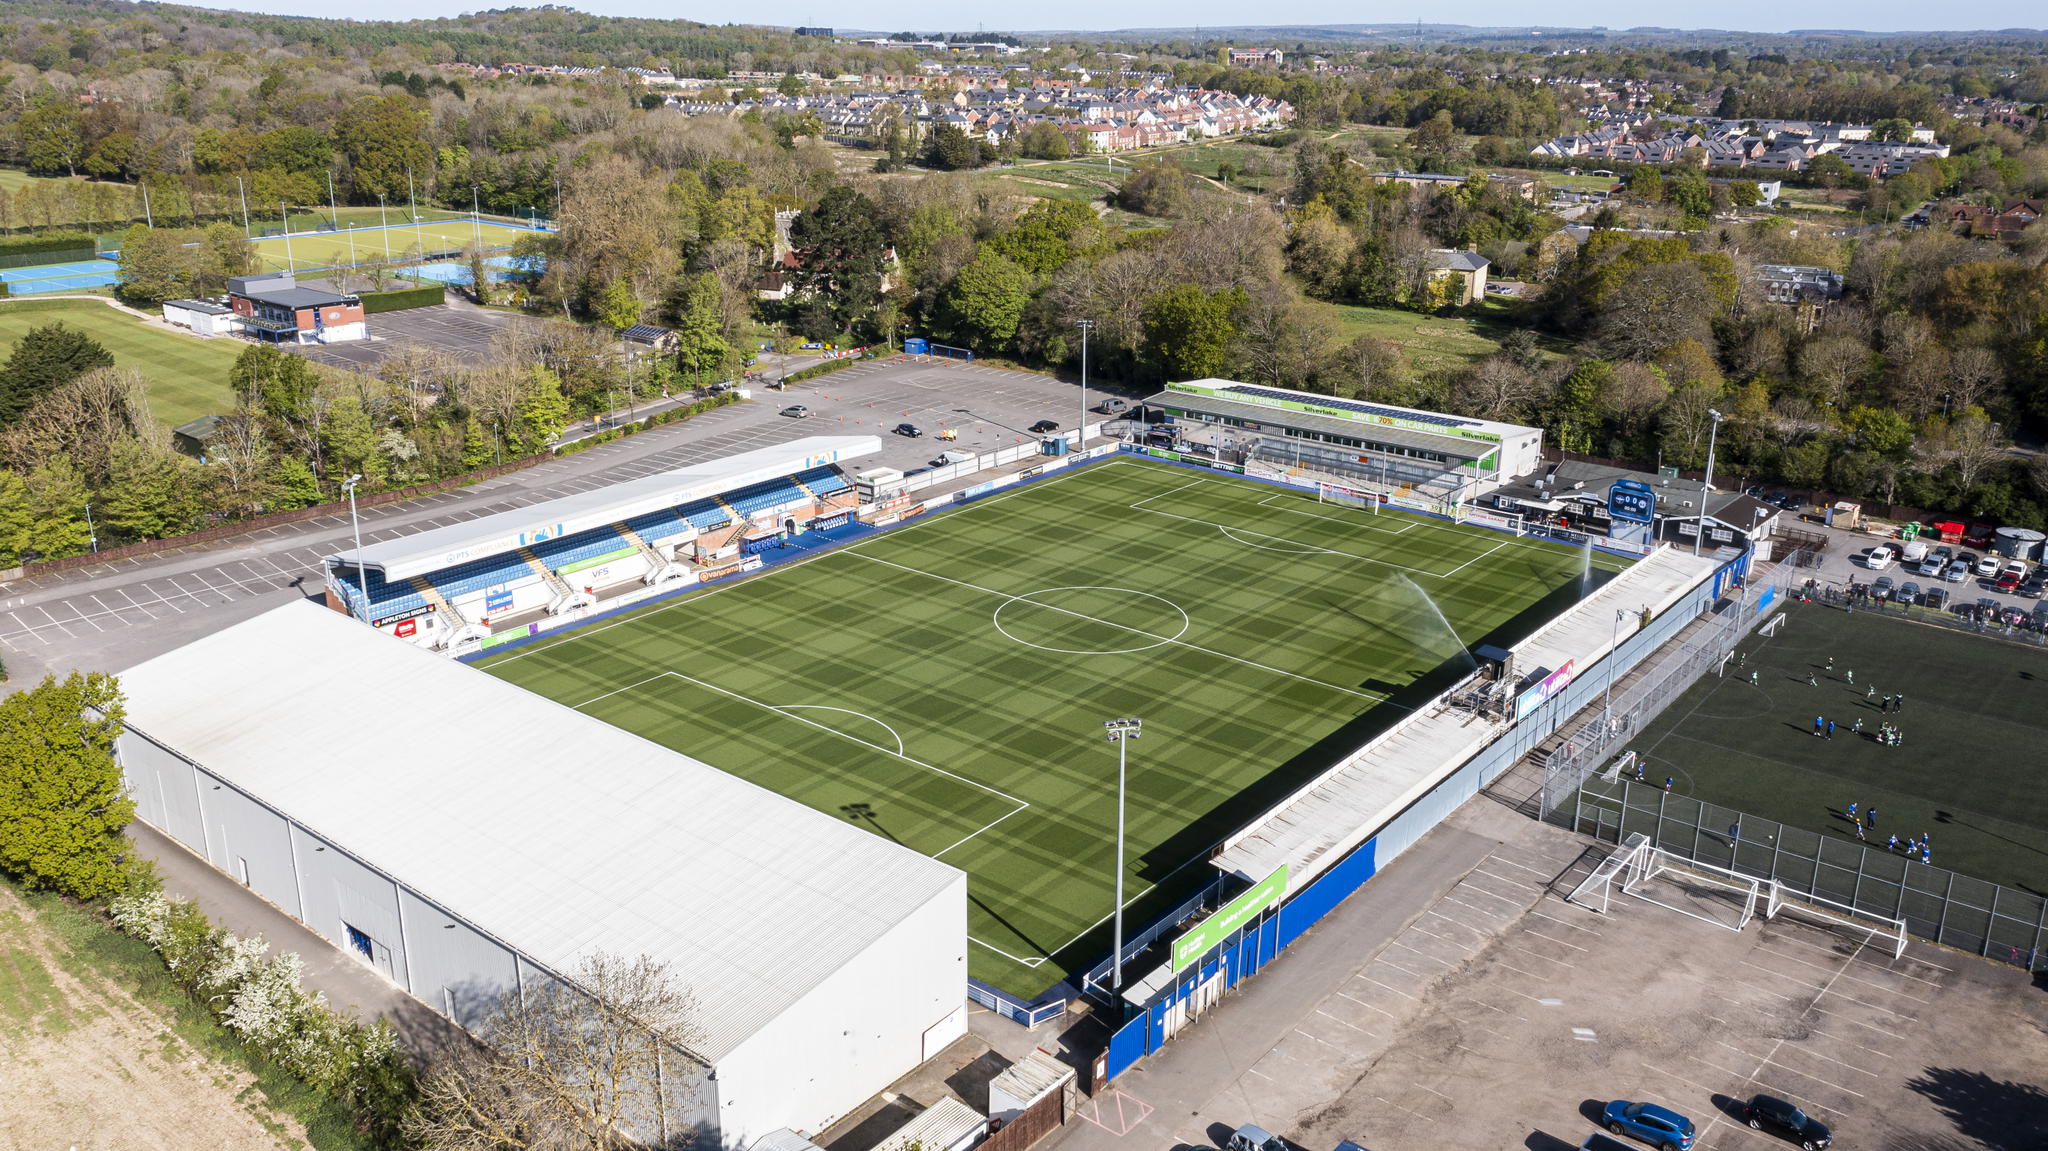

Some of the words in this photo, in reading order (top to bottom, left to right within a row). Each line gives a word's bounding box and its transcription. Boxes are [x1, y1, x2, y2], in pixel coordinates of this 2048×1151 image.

[1379, 416, 1393, 425] 70%
[1394, 419, 1407, 428] ON
[1407, 422, 1423, 431] CAR
[1424, 424, 1448, 434] PARTS
[1461, 431, 1500, 442] Silverlake
[591, 567, 609, 578] VFS
[708, 564, 739, 578] vanarama
[381, 612, 410, 625] APPLETON
[410, 607, 427, 616] SIGNS
